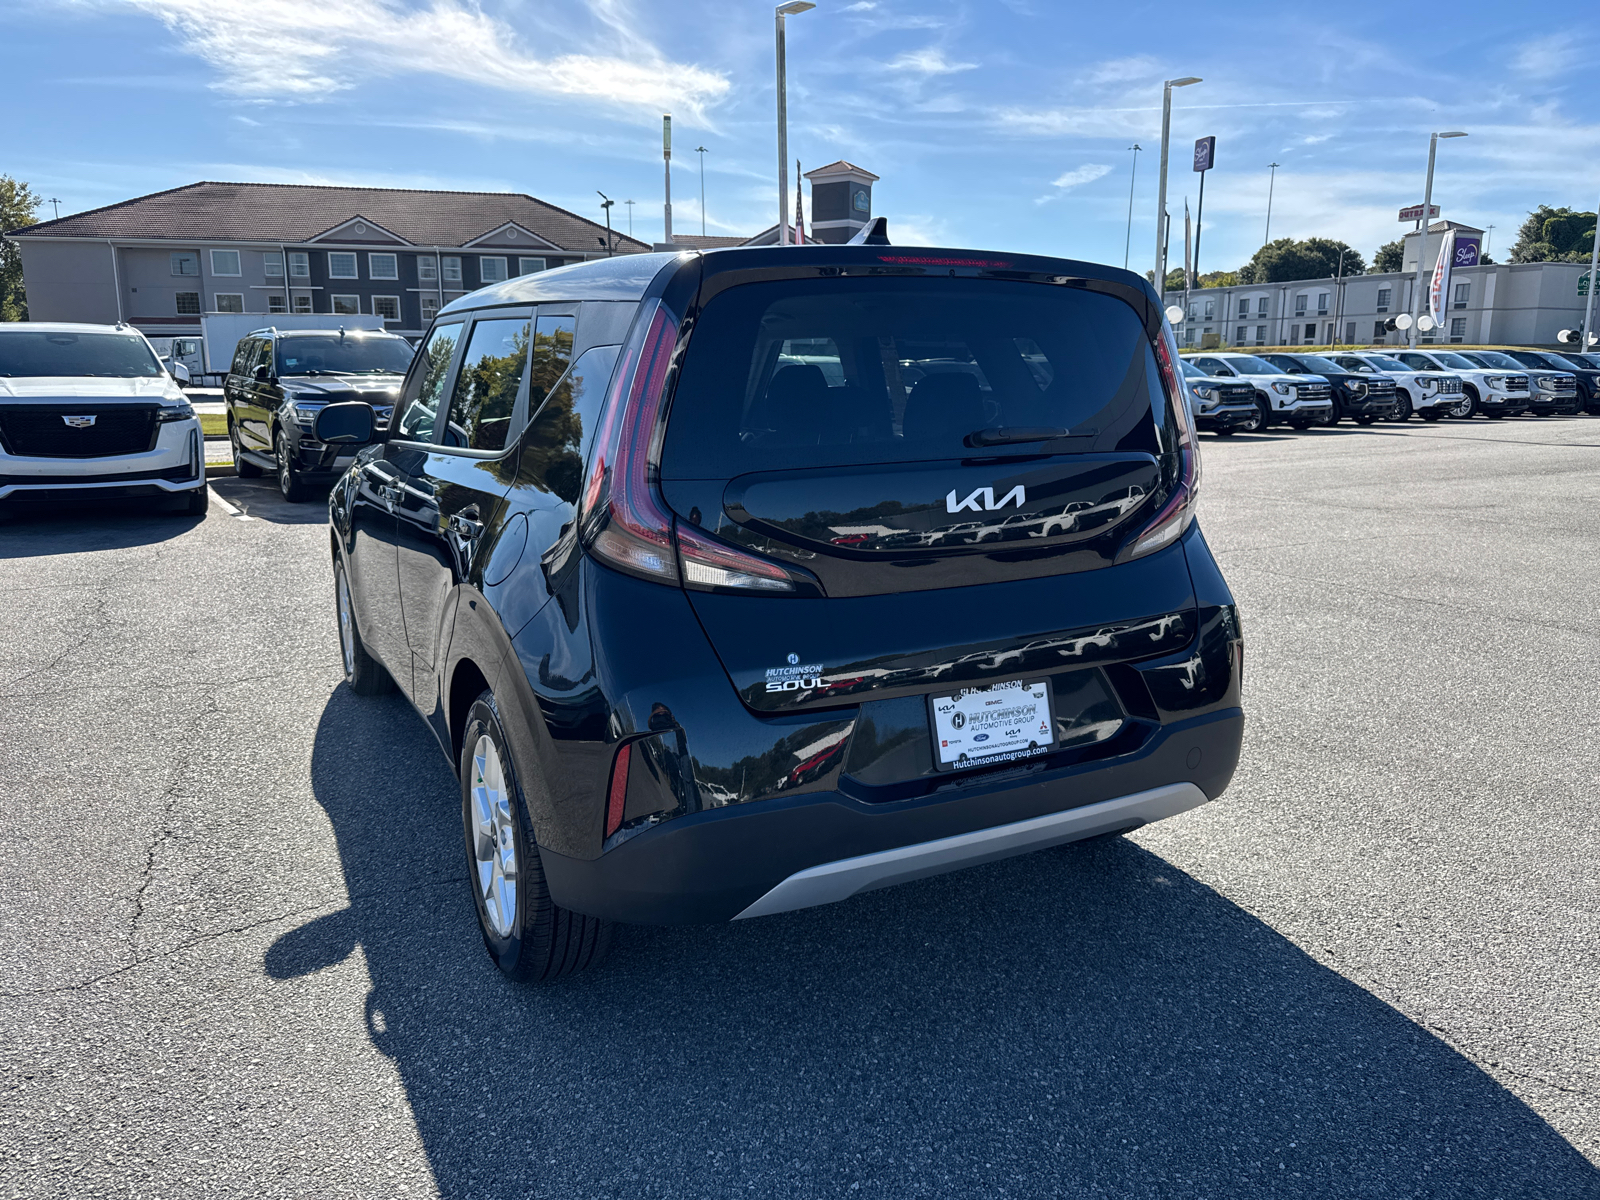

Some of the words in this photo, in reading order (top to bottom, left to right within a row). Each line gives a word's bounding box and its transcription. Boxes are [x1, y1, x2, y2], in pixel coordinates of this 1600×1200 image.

[1399, 208, 1436, 218] OUTBAK
[1455, 247, 1475, 263] Sleep
[946, 485, 1026, 514] KIA
[766, 665, 822, 677] HUTCHINSON
[766, 677, 832, 693] SOUL
[938, 704, 955, 712] KIA
[968, 704, 1037, 724] HUTCHINSON
[970, 719, 1012, 732] AUTOMOTIVE
[1013, 715, 1035, 725] GROUP
[1005, 728, 1021, 736] KIA
[967, 738, 1029, 752] HUTCHINSONAUTOGROUP.COM
[953, 746, 1048, 769] Hutchinsonautogroup.com
